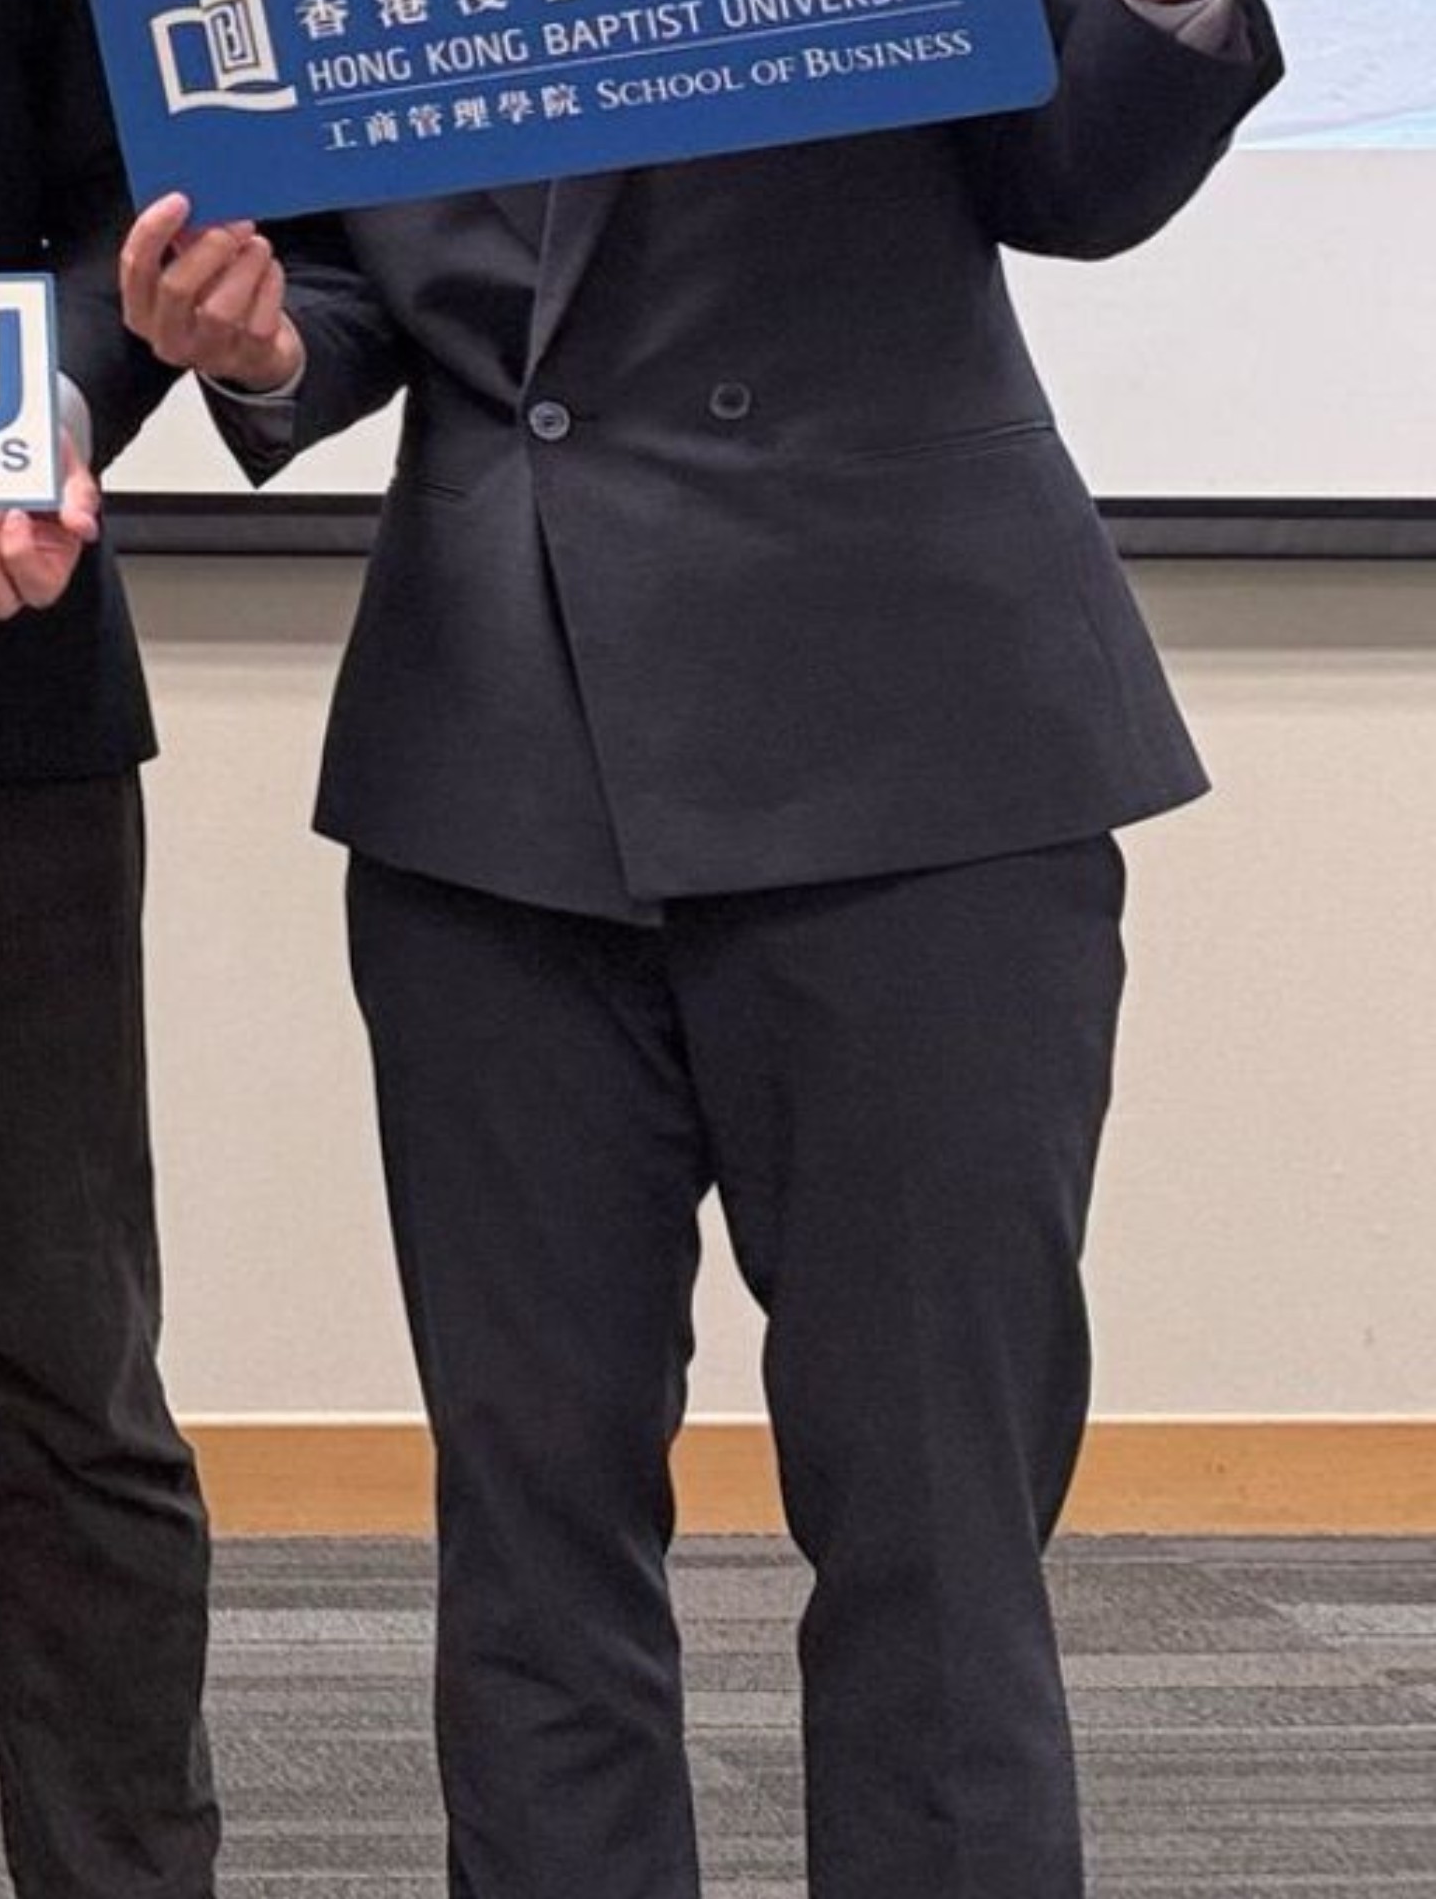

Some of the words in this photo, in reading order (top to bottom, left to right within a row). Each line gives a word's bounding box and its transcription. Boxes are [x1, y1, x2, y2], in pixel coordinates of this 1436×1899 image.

[307, 47, 411, 92] HONG
[425, 28, 528, 75] KONG
[543, 0, 703, 56] BAPTIST
[324, 83, 583, 151] 工商管理學院
